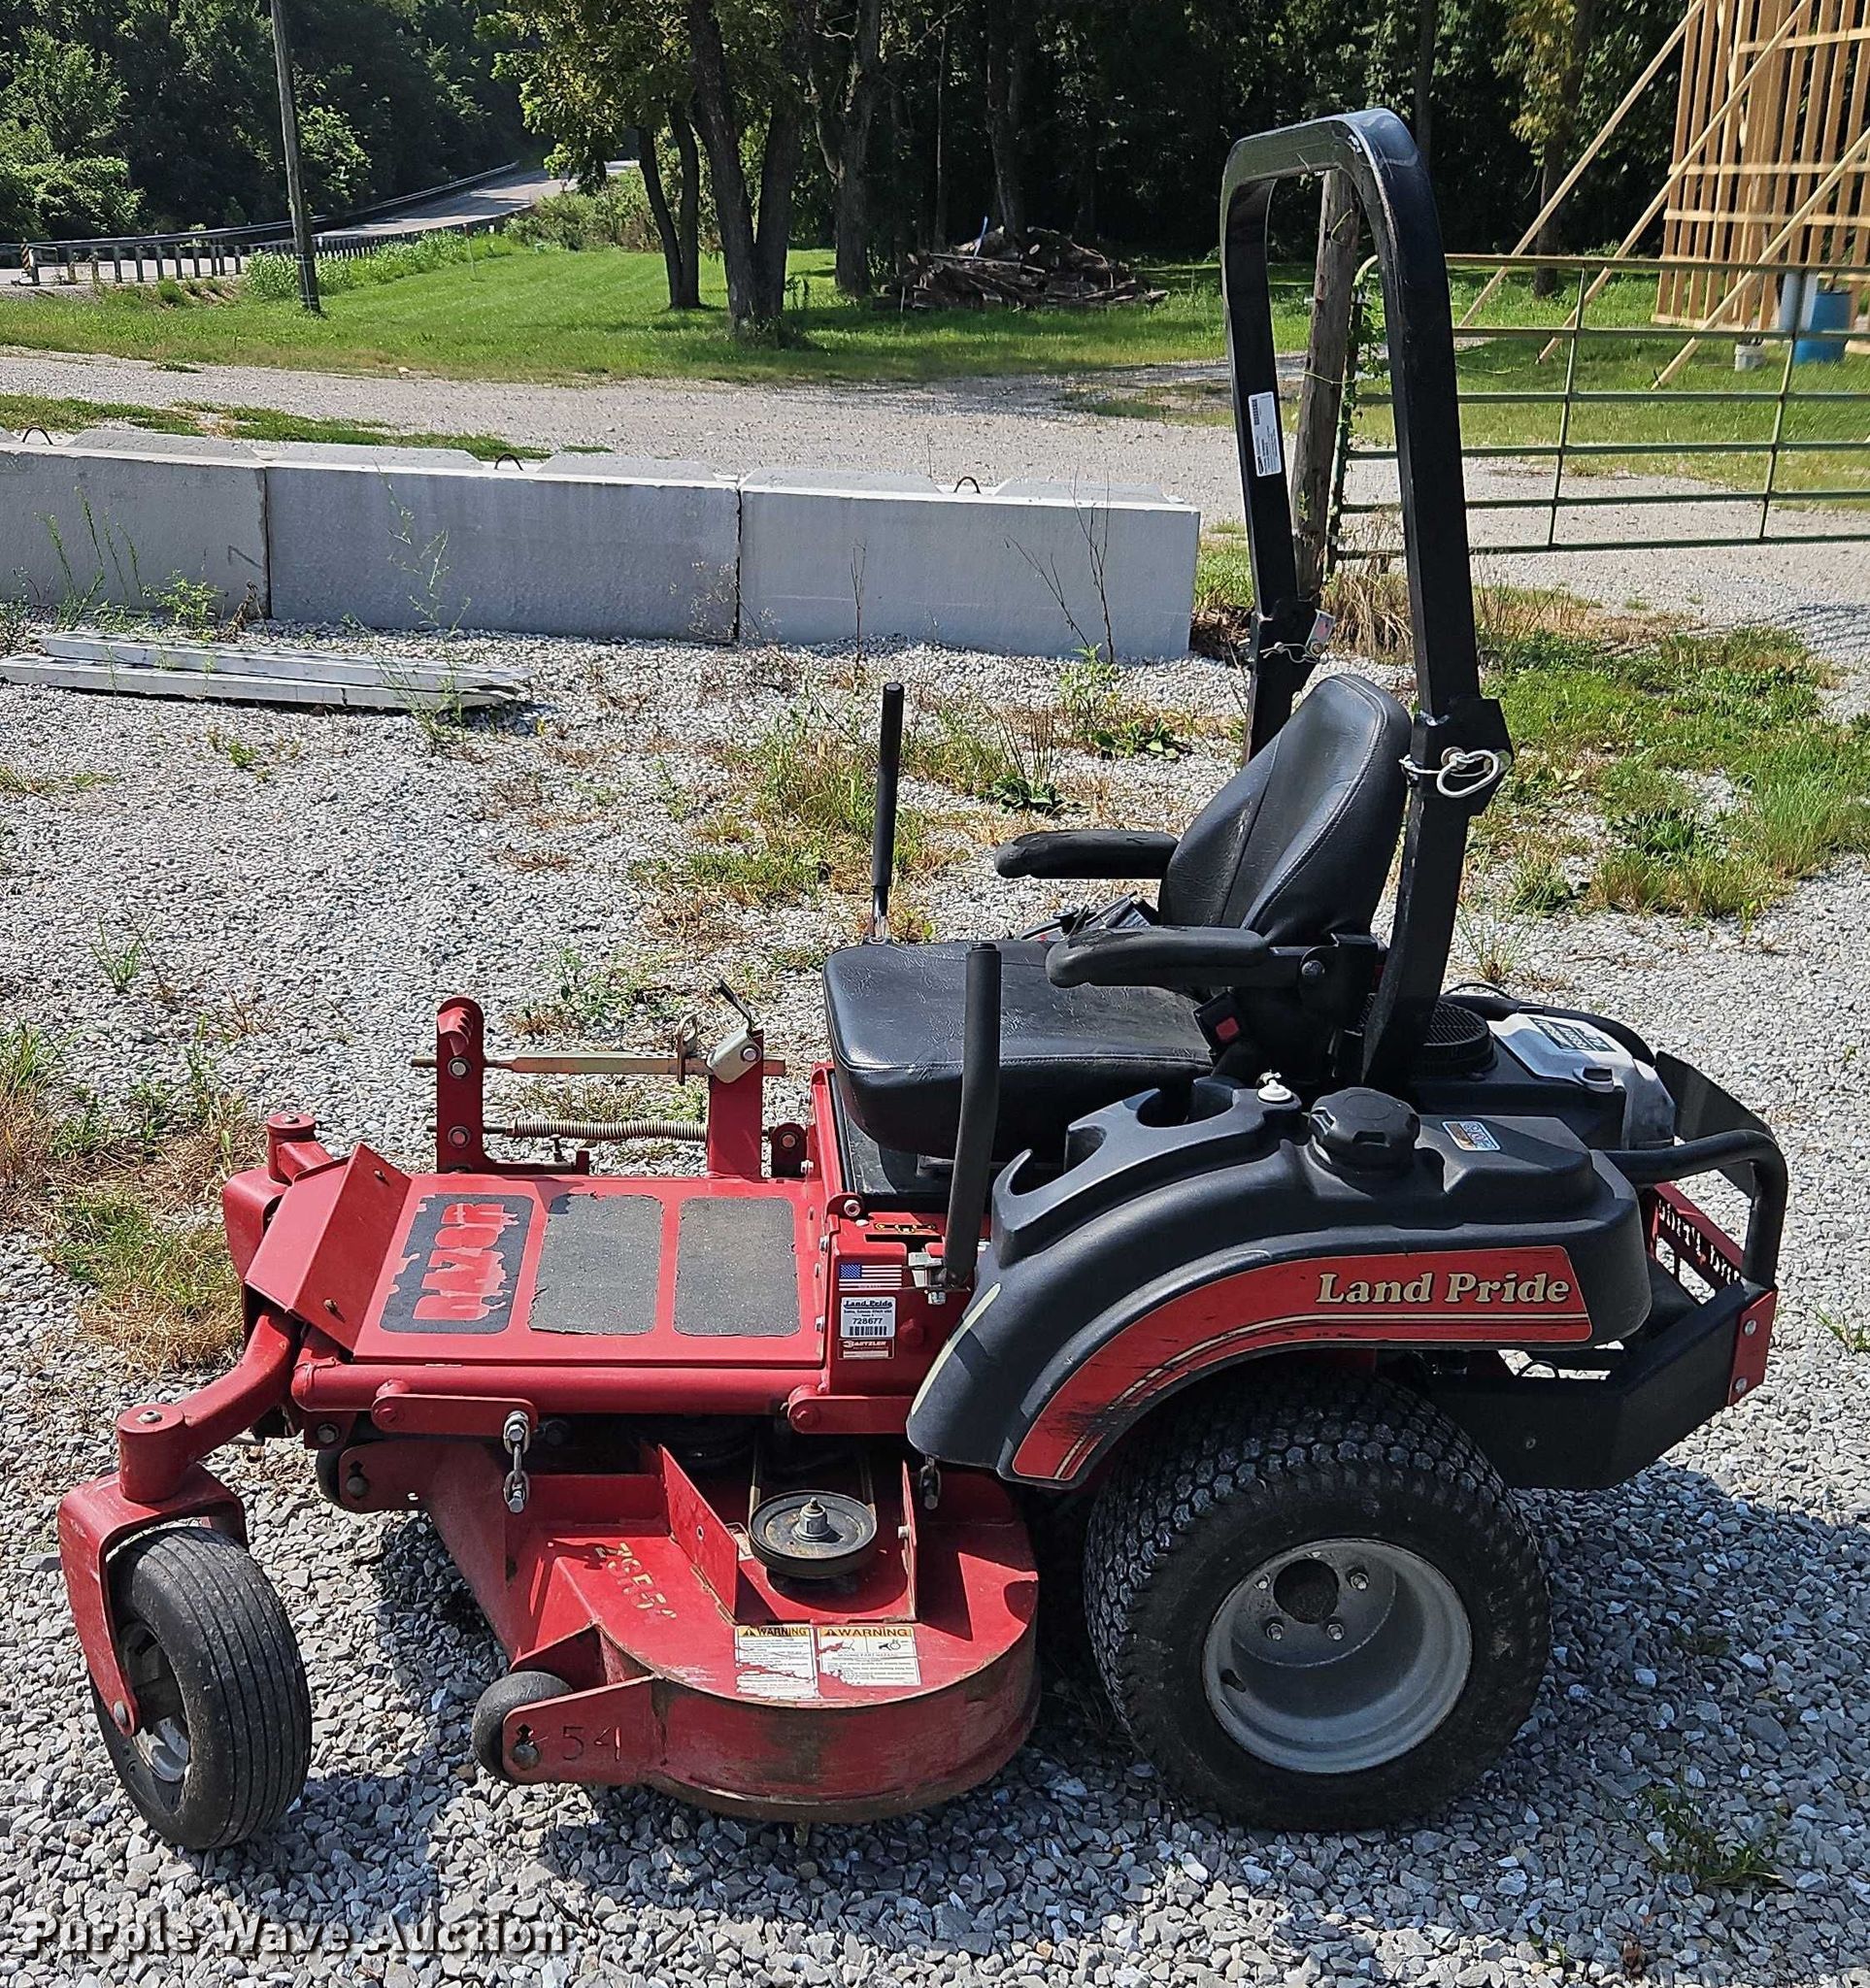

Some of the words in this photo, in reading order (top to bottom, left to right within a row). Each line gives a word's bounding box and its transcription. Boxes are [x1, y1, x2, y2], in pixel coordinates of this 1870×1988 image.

[1315, 1271, 1435, 1305] Land
[1444, 1271, 1571, 1305] Pride
[758, 1626, 808, 1638] WARNING
[837, 1628, 909, 1638] WARNING
[562, 1726, 622, 1762] 54
